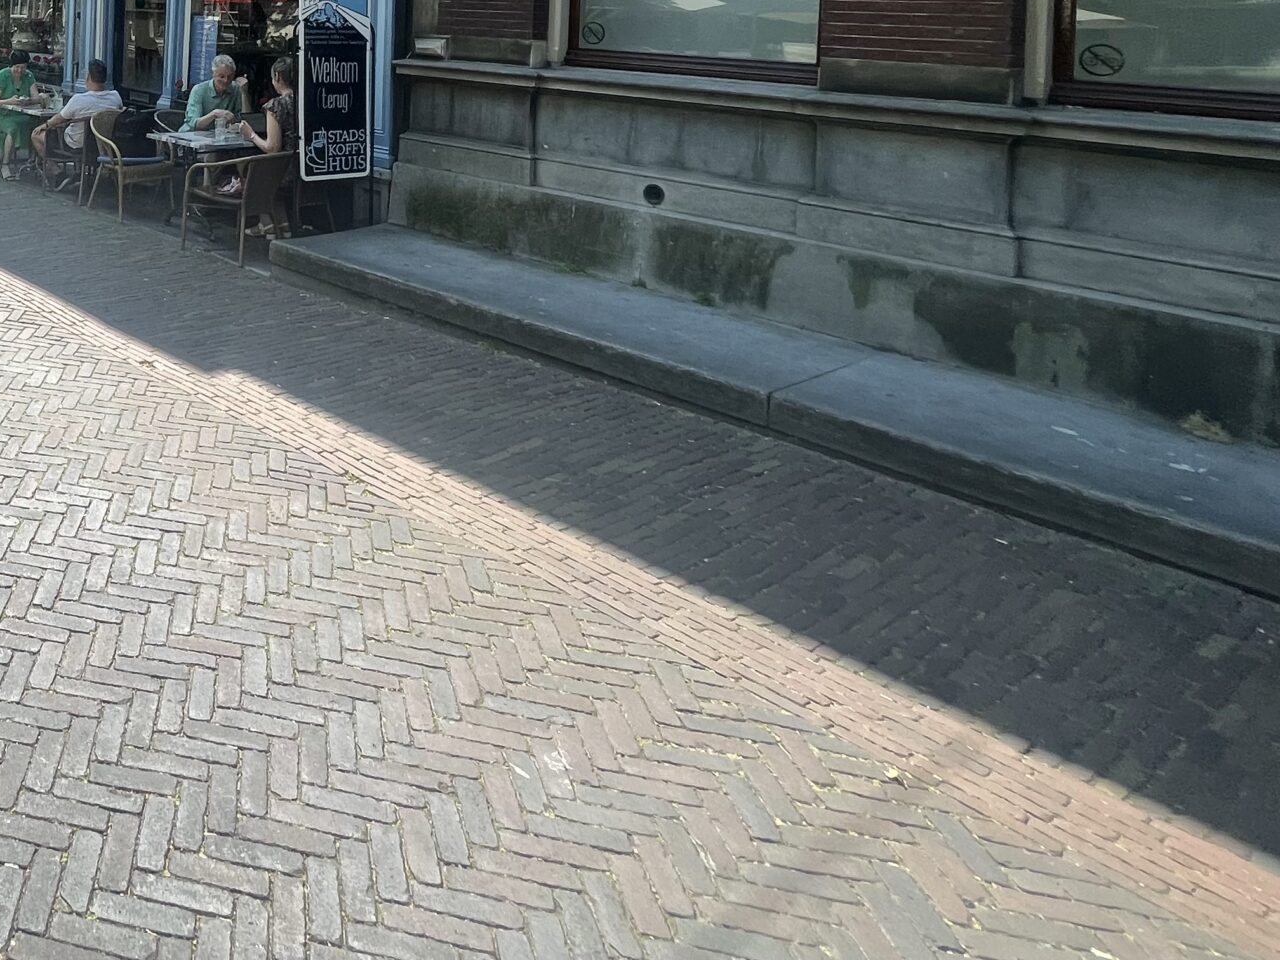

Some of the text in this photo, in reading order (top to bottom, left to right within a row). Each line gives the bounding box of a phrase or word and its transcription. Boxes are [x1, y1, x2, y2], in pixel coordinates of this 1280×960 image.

[328, 129, 366, 142] STADS
[328, 143, 366, 156] KOFFY
[328, 155, 366, 172] HUIS
